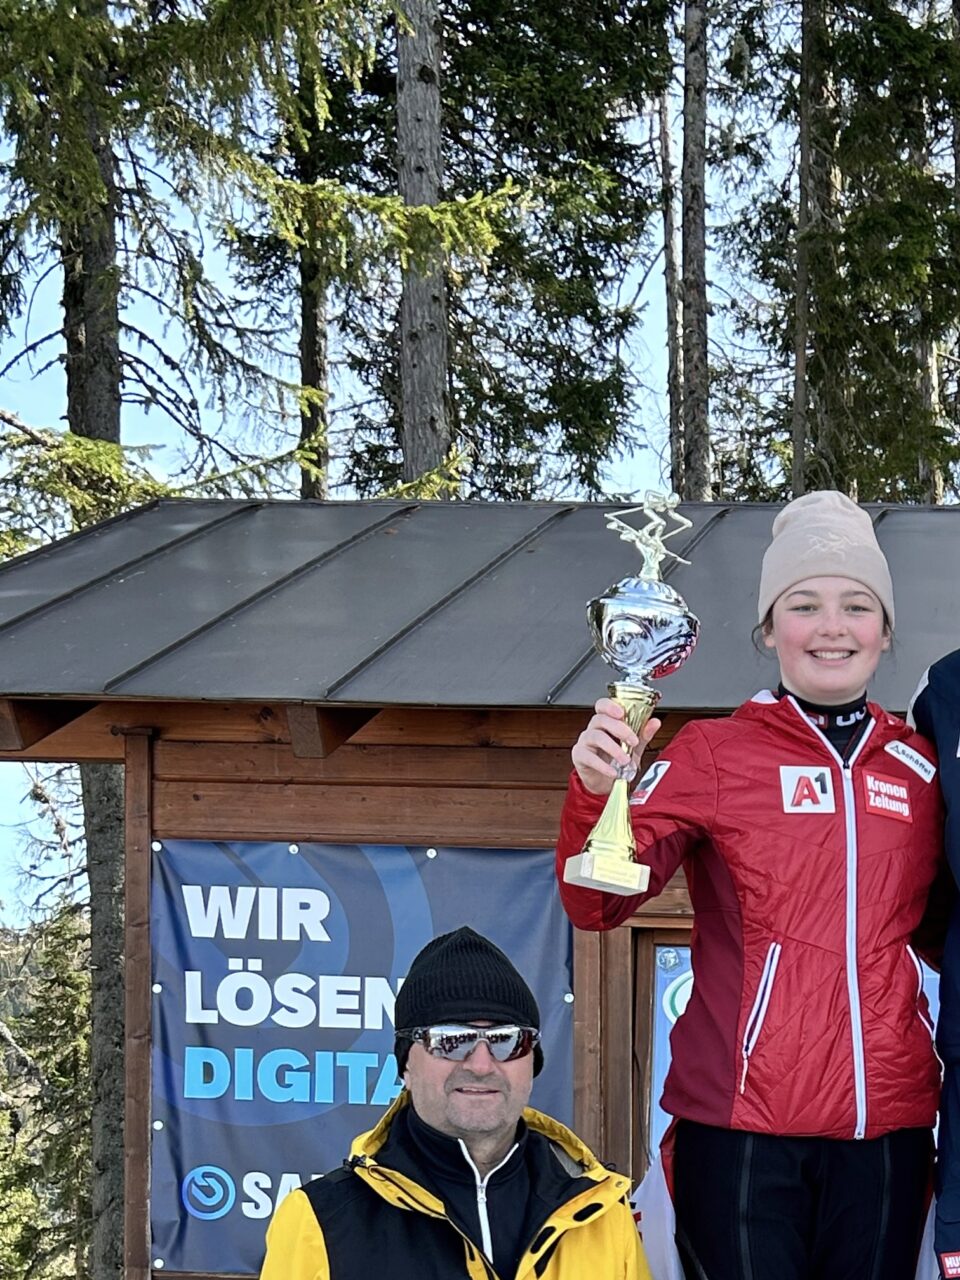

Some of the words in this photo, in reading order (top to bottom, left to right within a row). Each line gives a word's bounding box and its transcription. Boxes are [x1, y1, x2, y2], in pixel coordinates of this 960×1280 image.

[791, 772, 828, 807] A1
[866, 774, 908, 800] Kronen
[868, 792, 910, 817] Zeitung
[182, 885, 331, 942] WIR
[185, 958, 404, 1030] LÖSEN
[241, 1171, 325, 1219] SA
